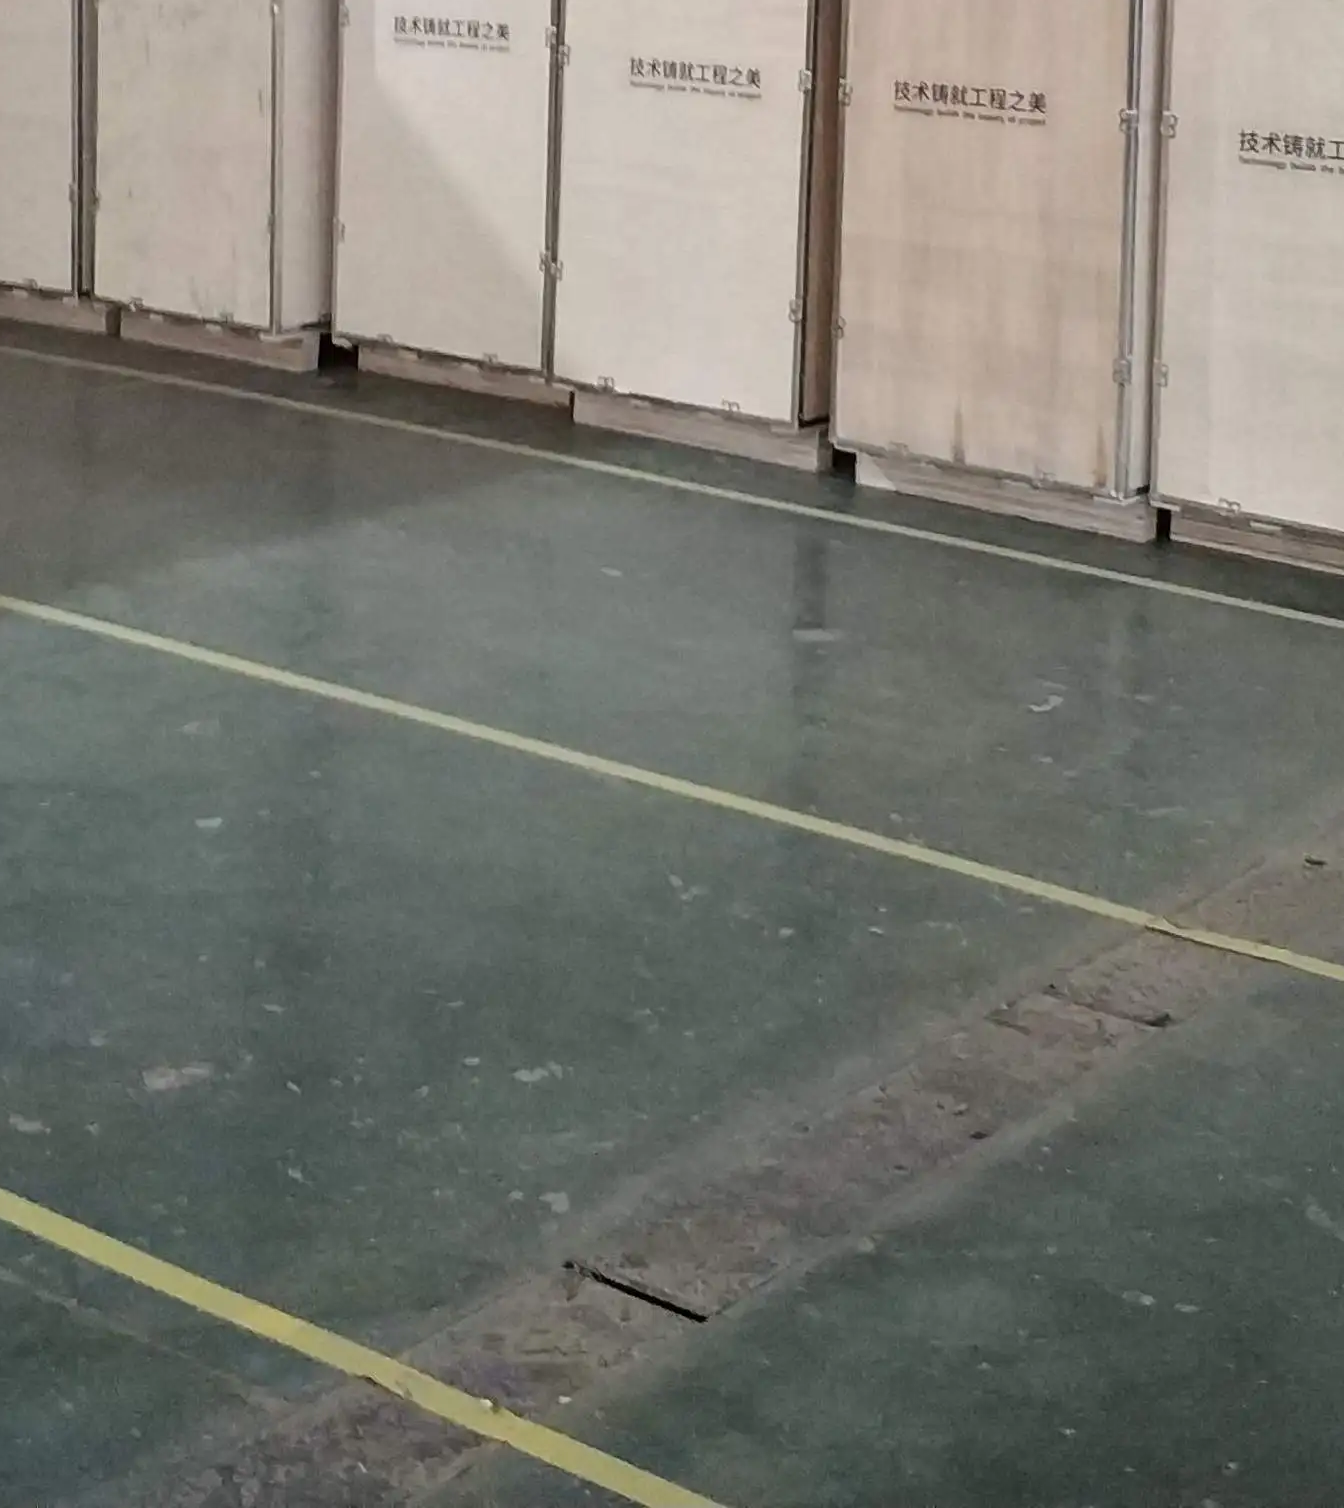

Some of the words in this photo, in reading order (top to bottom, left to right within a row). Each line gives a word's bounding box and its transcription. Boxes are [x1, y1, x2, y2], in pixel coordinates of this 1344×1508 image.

[630, 57, 761, 89] 技术铸就工程之美
[894, 80, 1046, 114] 技术铸就工程之美
